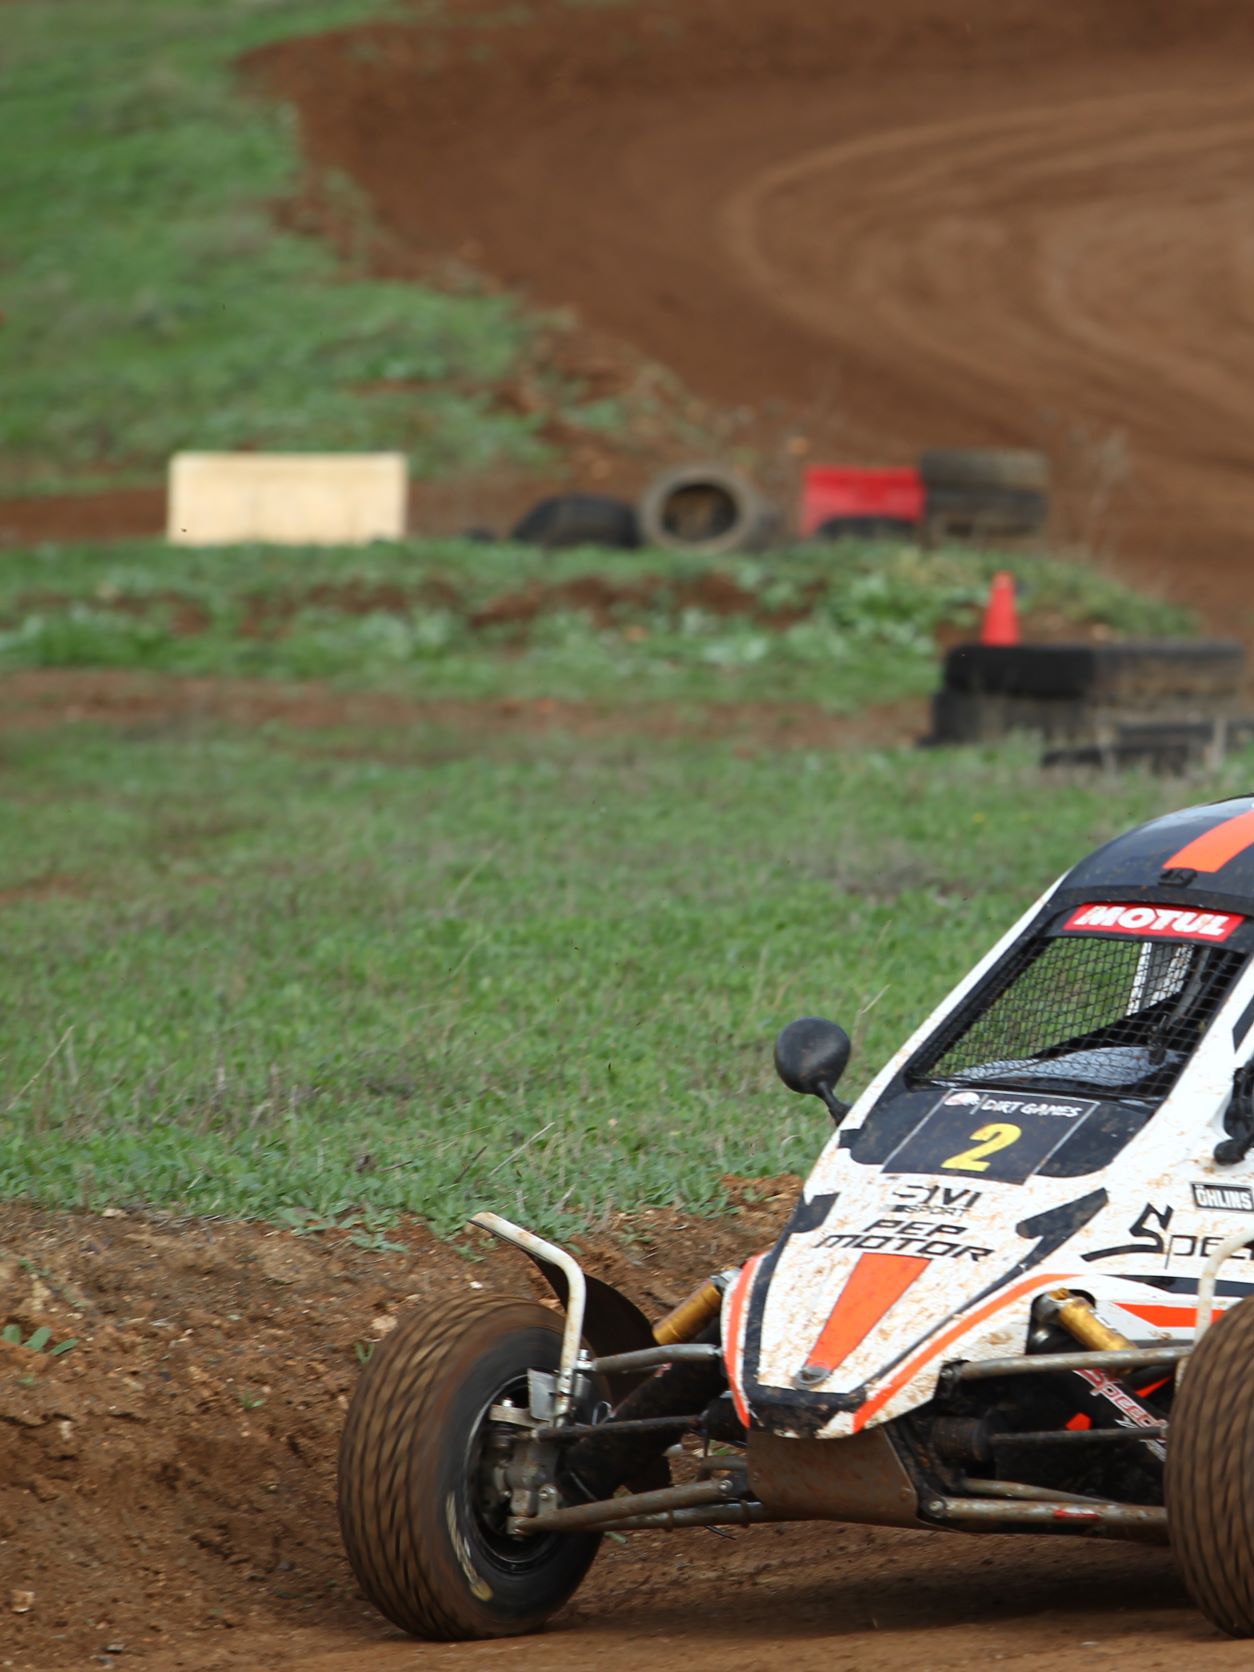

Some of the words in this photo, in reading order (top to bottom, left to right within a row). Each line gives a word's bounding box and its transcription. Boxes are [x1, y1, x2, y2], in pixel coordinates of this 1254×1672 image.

[1073, 905, 1230, 936] MOTUL
[981, 1100, 1024, 1114] DIRT
[1020, 1103, 1083, 1118] GAMES
[940, 1122, 1023, 1172] 2
[862, 1219, 968, 1237] PEP
[813, 1235, 995, 1262] MOTOR
